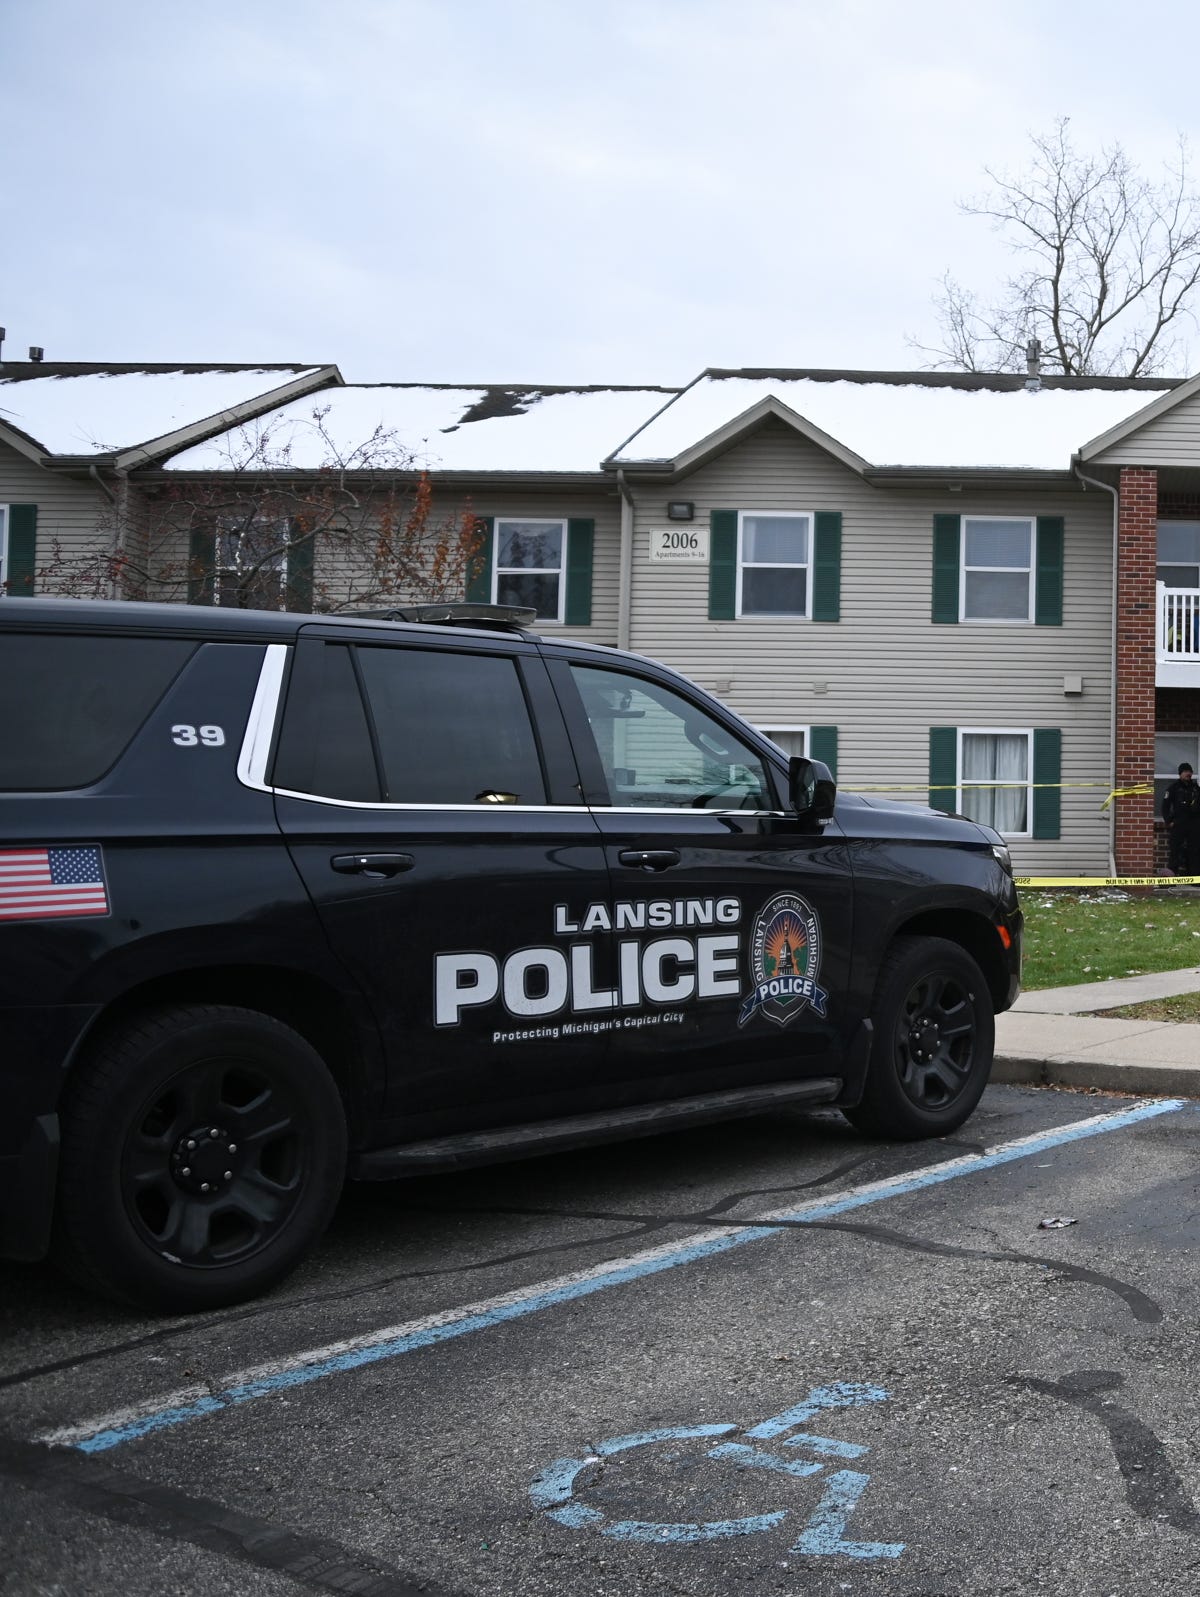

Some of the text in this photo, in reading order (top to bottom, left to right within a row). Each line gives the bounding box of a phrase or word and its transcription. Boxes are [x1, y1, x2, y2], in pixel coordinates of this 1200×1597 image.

[662, 532, 698, 549] 2006
[655, 551, 690, 559] Apartments
[171, 724, 226, 747] 39
[555, 899, 741, 933] LANSING
[772, 899, 789, 912] SINCE
[754, 920, 766, 981] LANSING
[807, 917, 817, 978] MICHIGAN
[435, 934, 741, 1026] POLICE
[759, 978, 813, 1001] POLICE
[493, 1012, 685, 1043] Protecting Michigan's Capital City
